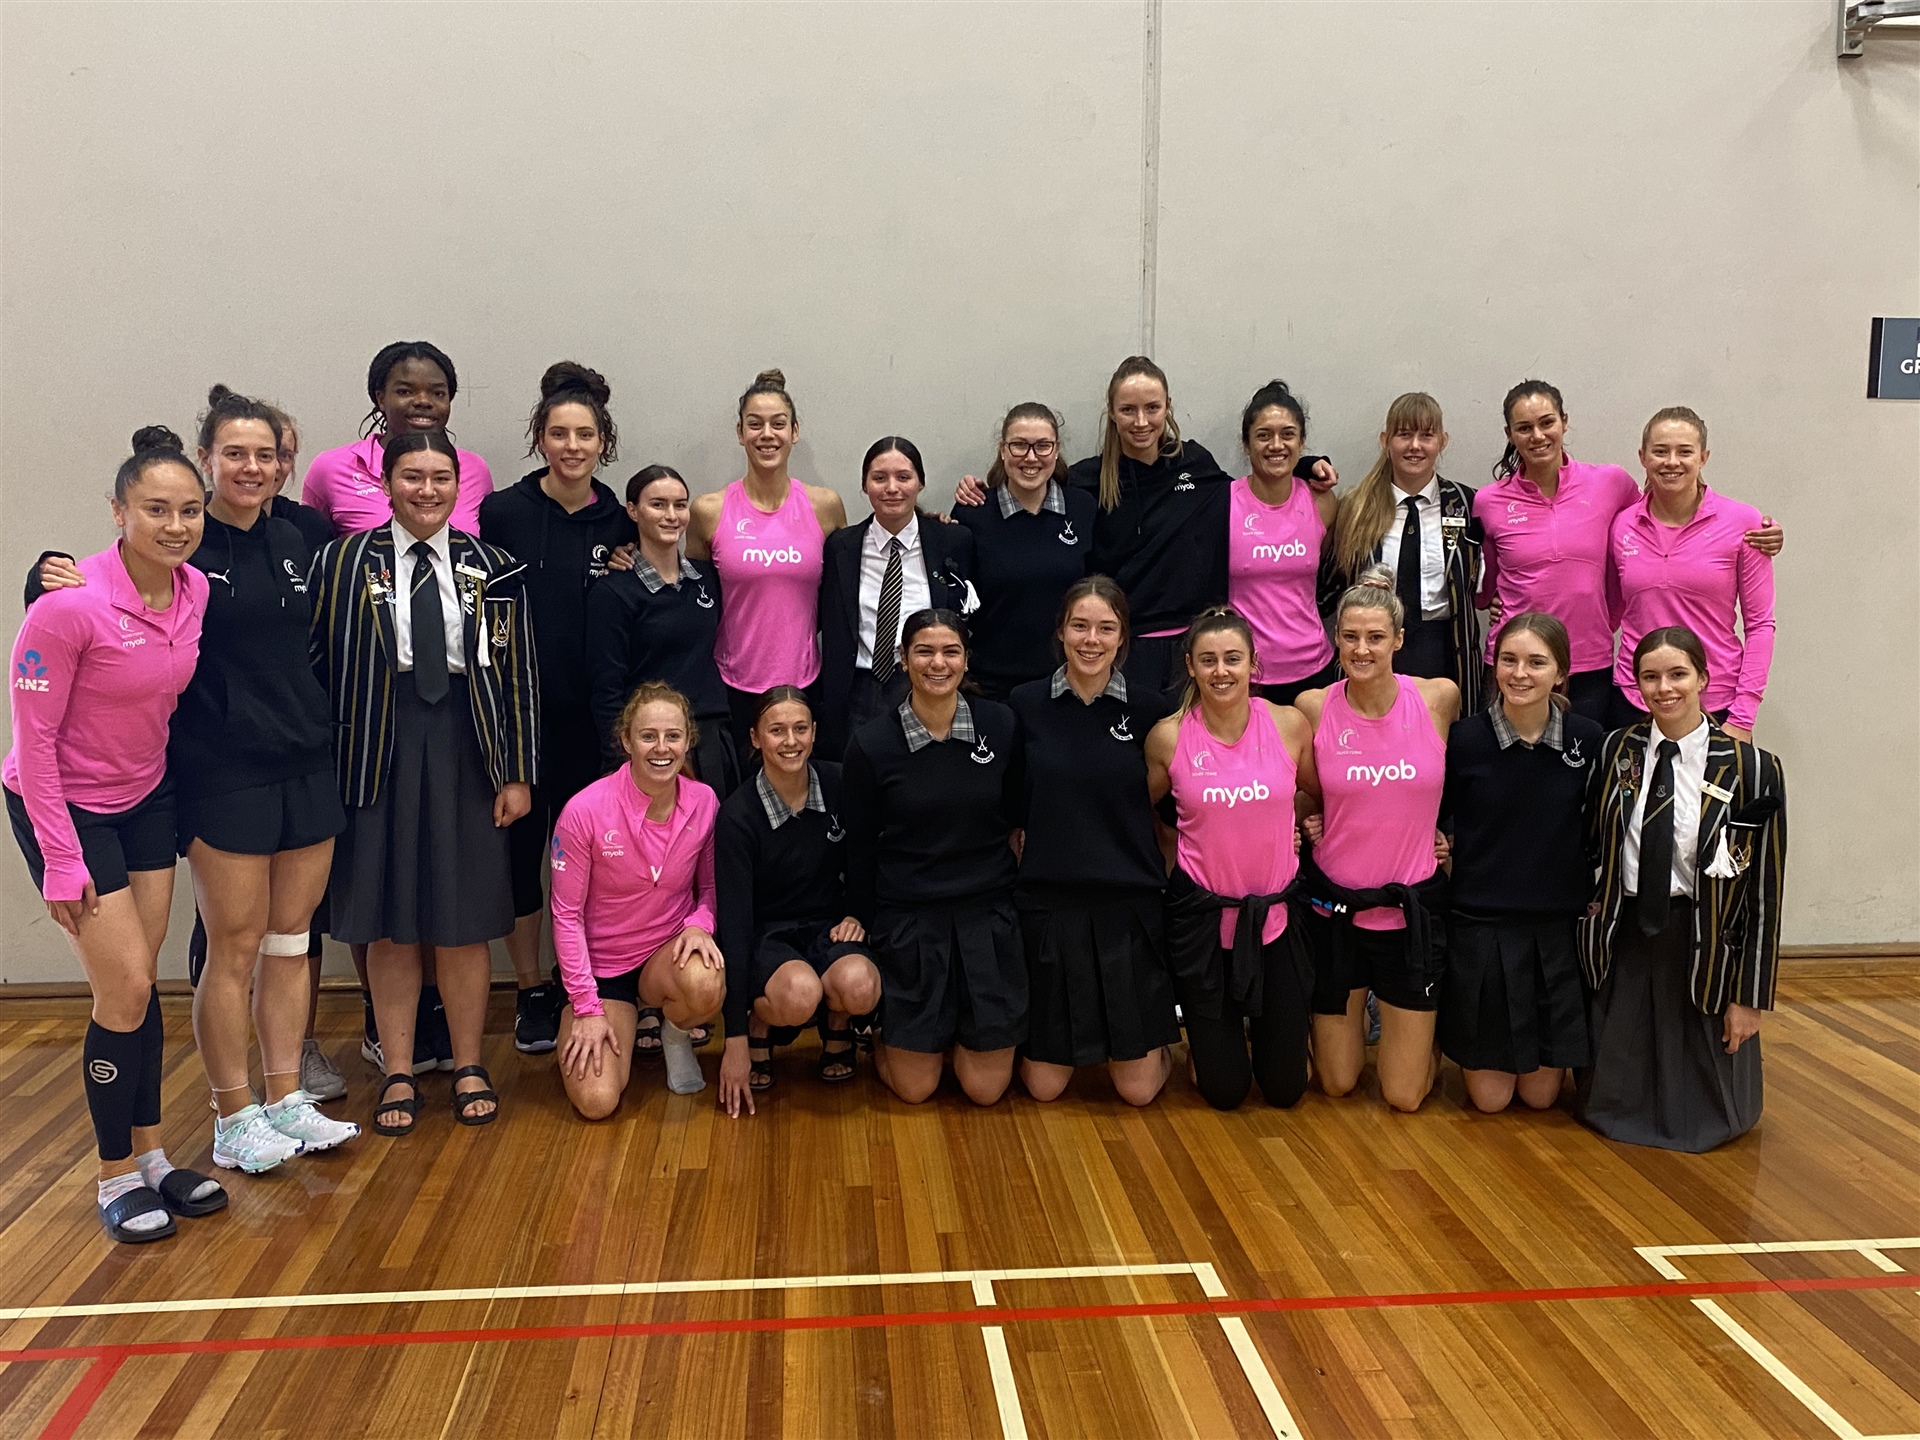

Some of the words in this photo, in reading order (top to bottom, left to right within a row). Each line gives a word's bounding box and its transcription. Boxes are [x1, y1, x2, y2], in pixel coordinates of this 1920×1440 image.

[742, 545, 802, 567] myob
[1252, 538, 1306, 563] myob
[122, 637, 146, 648] myob
[14, 677, 50, 692] ANZ
[1346, 758, 1417, 787] myob
[1202, 779, 1270, 809] myob
